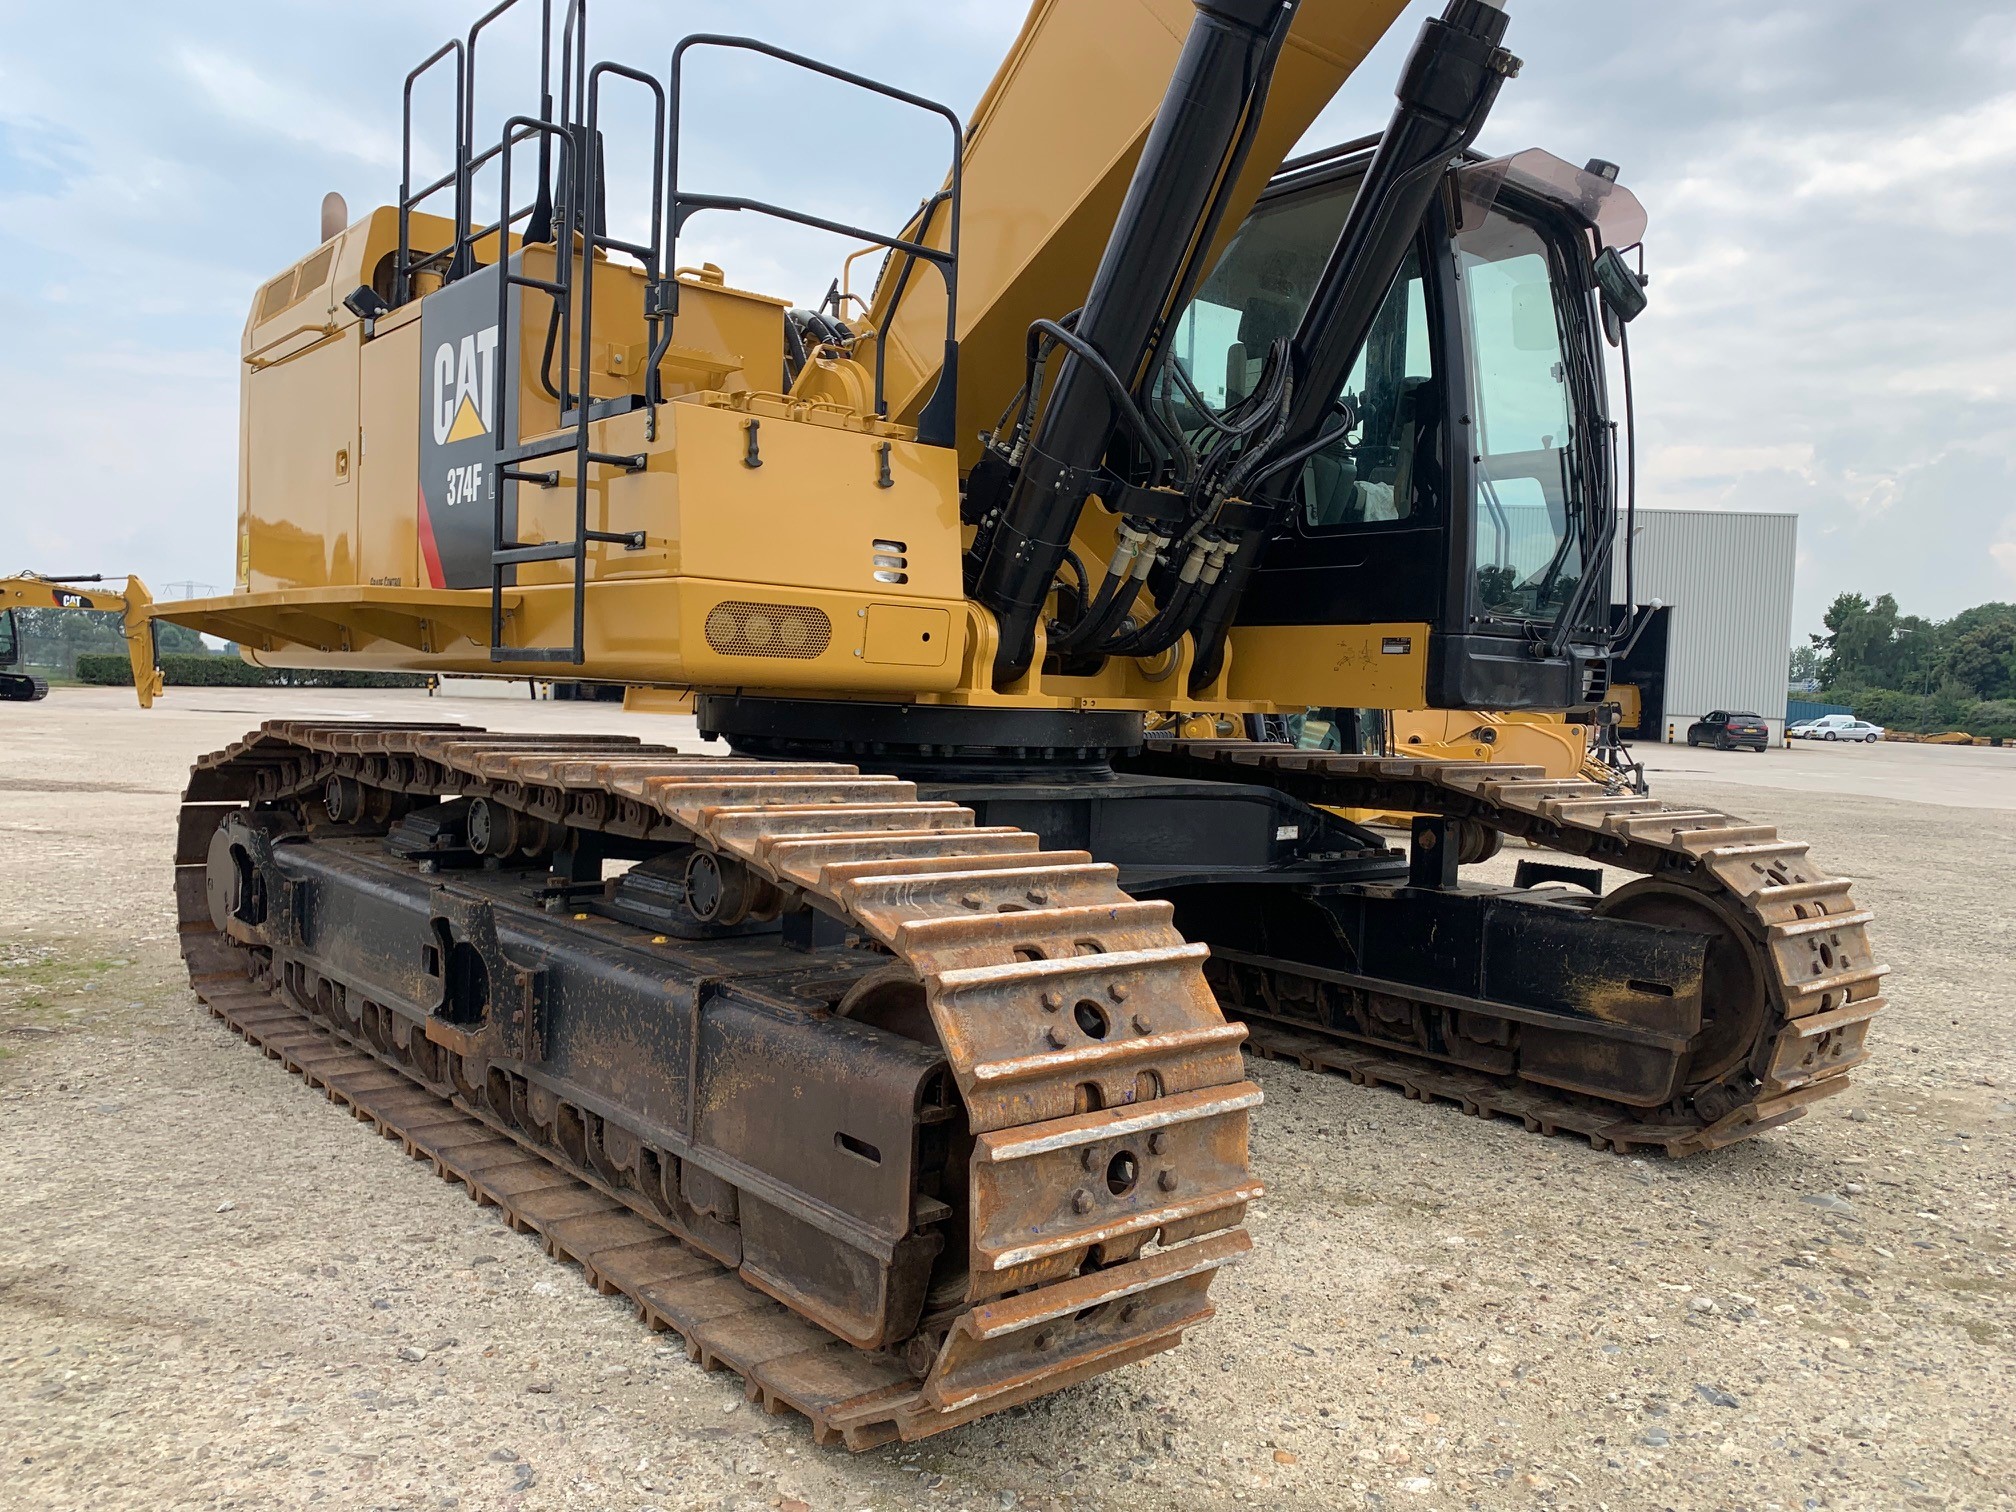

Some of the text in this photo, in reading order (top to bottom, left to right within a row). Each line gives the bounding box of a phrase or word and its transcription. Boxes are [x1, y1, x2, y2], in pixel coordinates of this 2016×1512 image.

[433, 324, 499, 446] CAT
[446, 462, 482, 506] 374F
[63, 595, 81, 607] CAT
